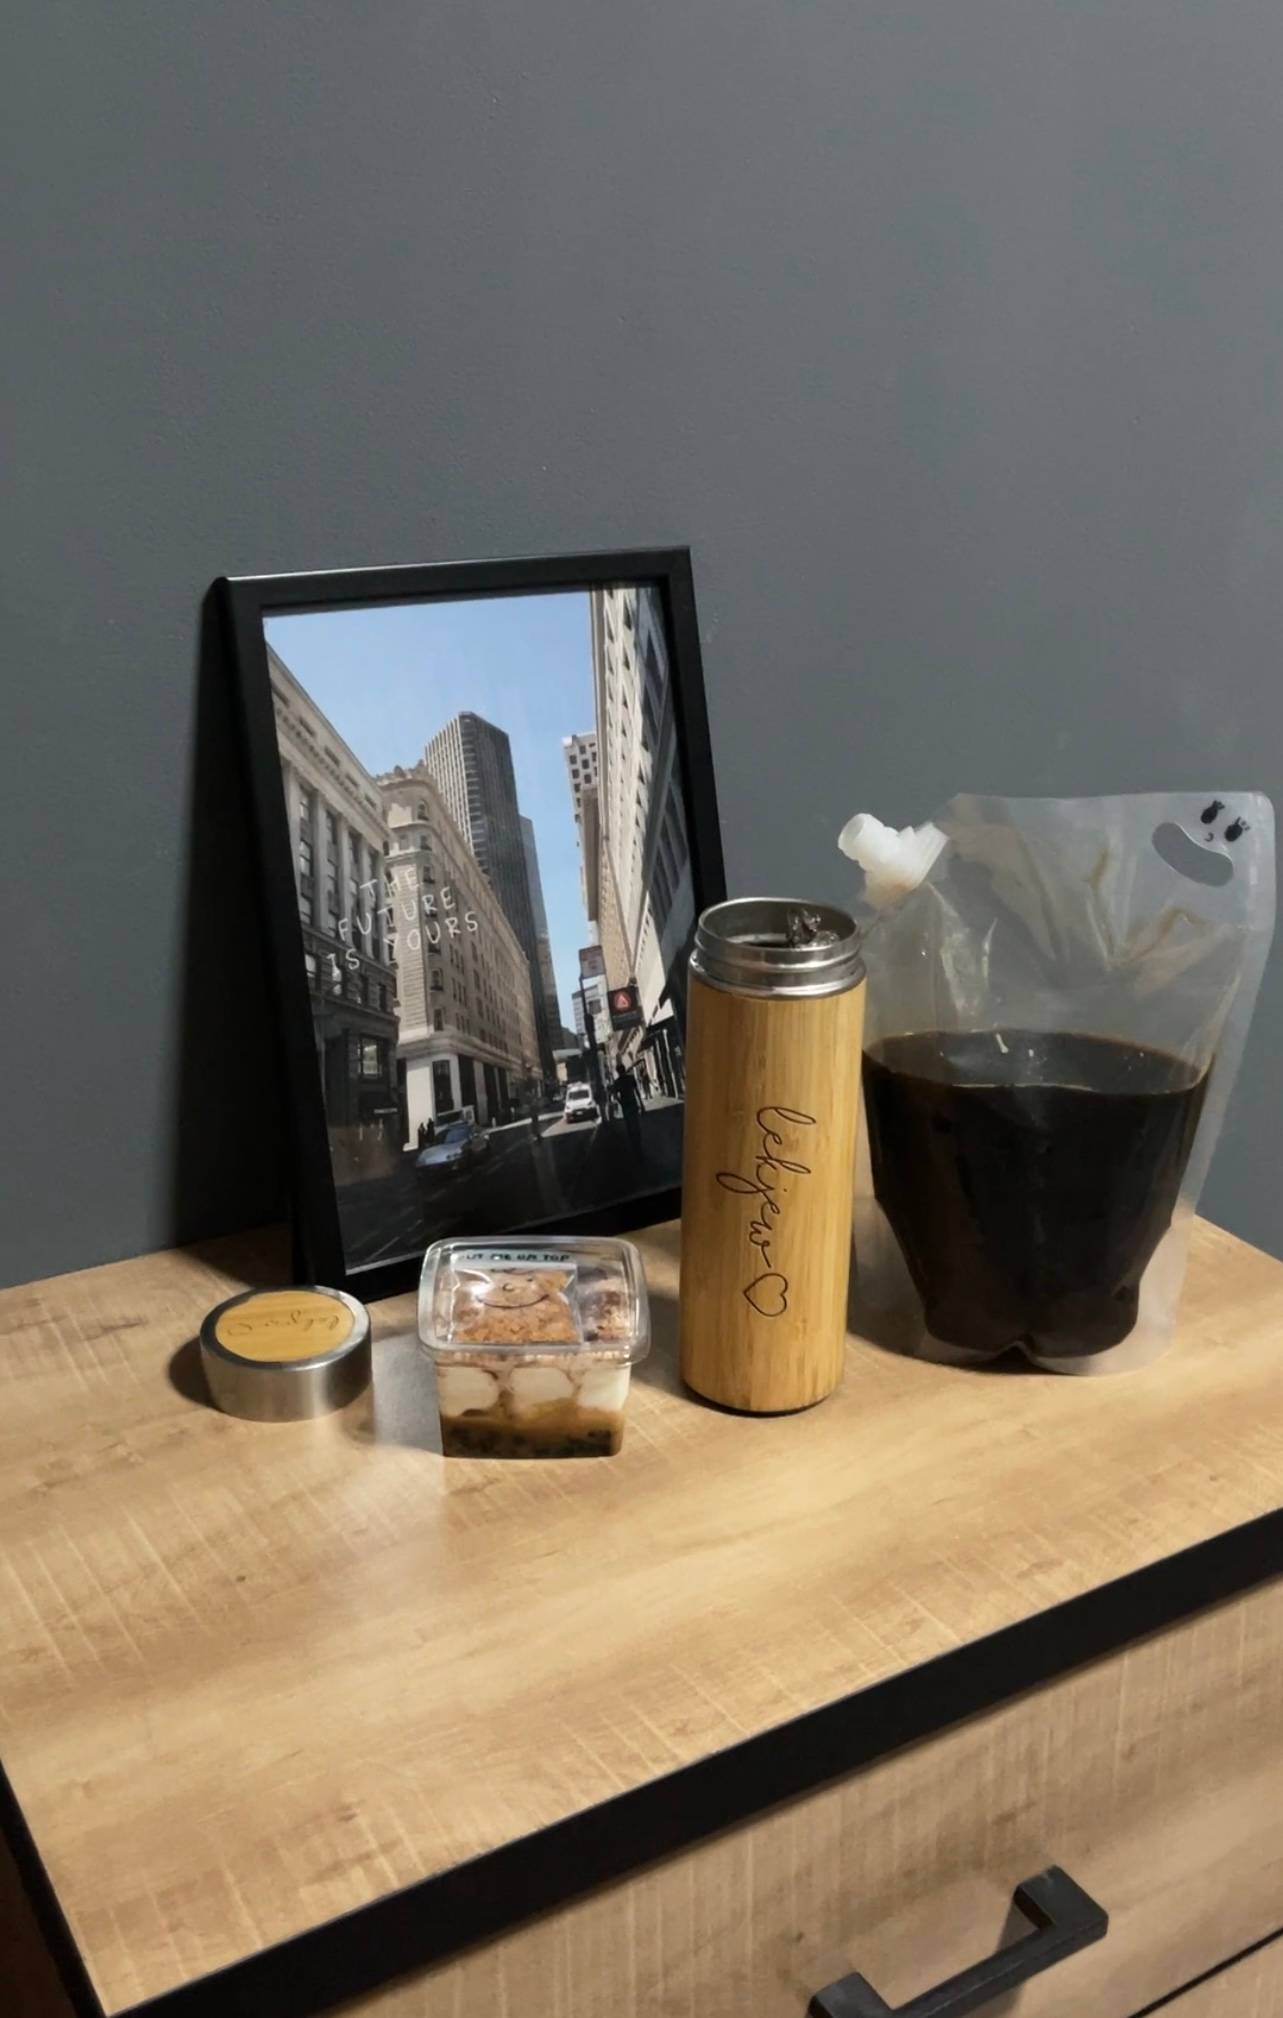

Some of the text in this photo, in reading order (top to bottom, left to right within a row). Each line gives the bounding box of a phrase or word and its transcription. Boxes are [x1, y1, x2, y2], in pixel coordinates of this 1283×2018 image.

[359, 868, 420, 900] THE
[337, 886, 456, 941] FUTURE
[326, 911, 479, 975] IS YOURS
